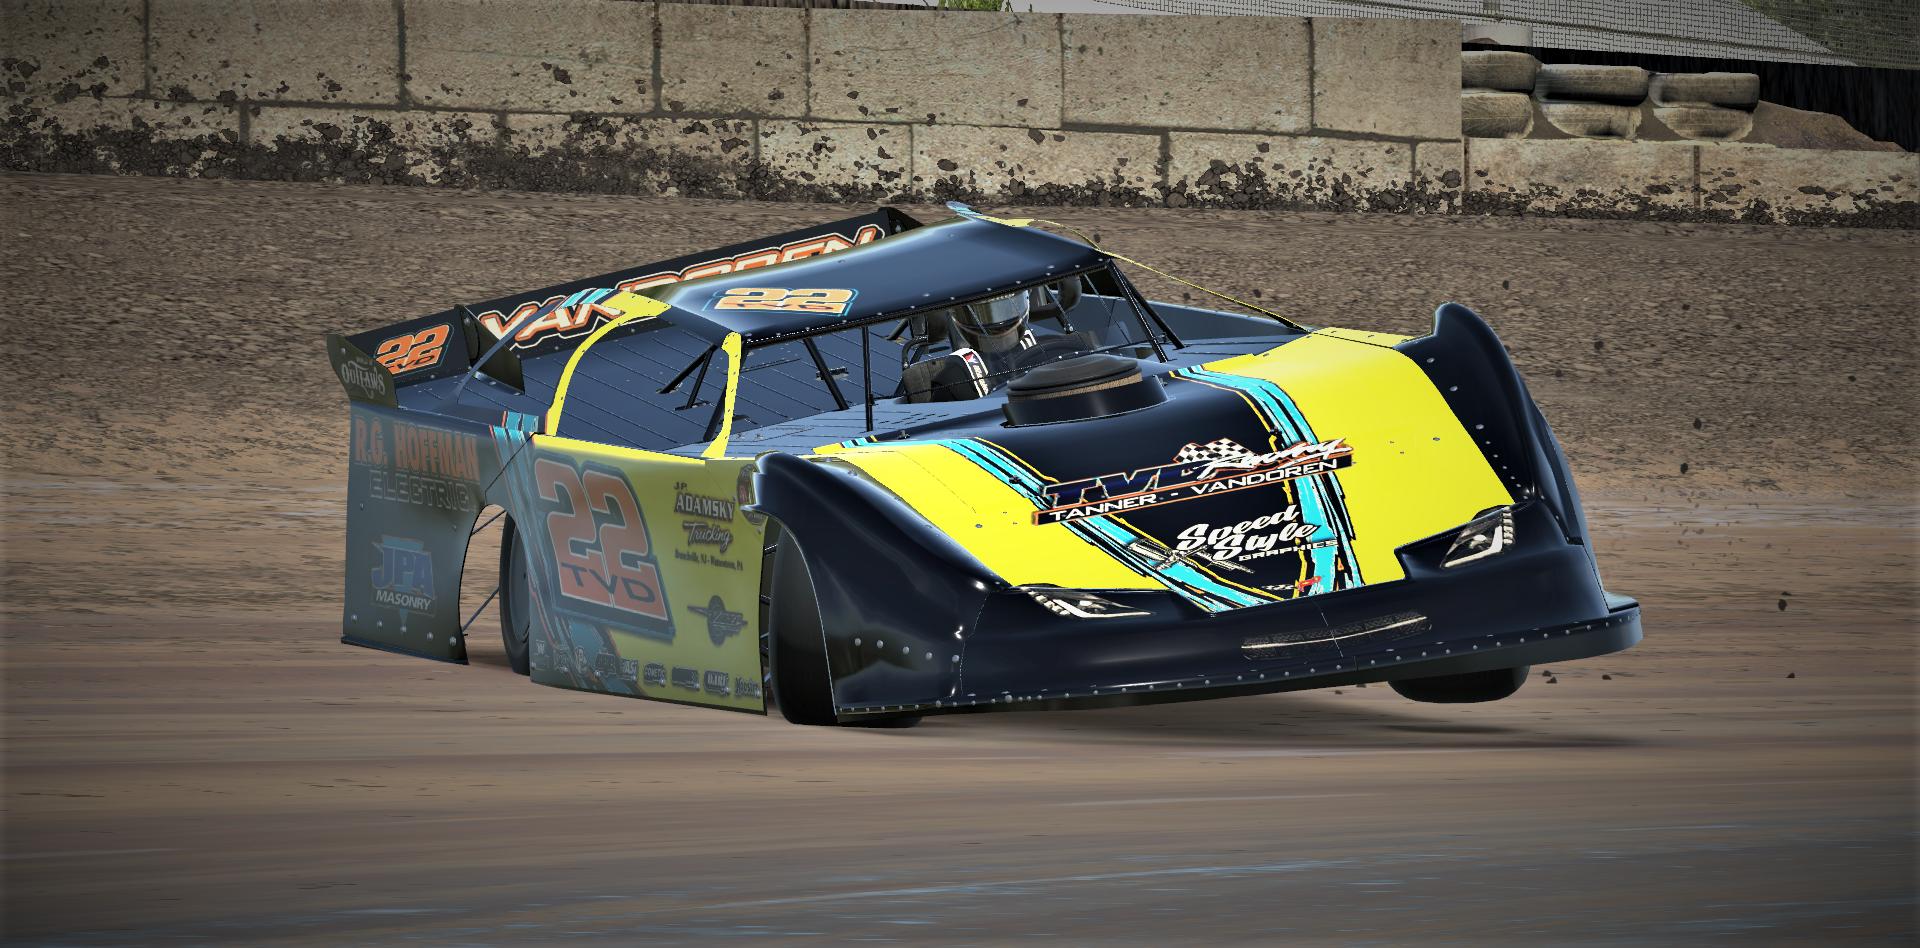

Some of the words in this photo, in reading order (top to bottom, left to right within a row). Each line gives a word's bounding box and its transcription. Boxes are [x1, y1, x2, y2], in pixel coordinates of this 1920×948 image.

[715, 287, 853, 314] 22
[376, 324, 450, 375] 22
[392, 422, 480, 482] HOFFMAN
[369, 469, 471, 513] ELECTRIC
[675, 493, 735, 520] ADAMSKY
[1049, 493, 1157, 521] TANNER
[1190, 458, 1338, 495] VANDOREN
[534, 458, 669, 621] 22
[682, 521, 733, 554] Trucking
[1176, 504, 1300, 551] Speed
[1212, 522, 1320, 561] Style
[1238, 539, 1338, 562] GRAPHICS
[370, 545, 435, 600] JPA
[560, 562, 656, 603] TVD
[375, 590, 432, 610] MASONRY
